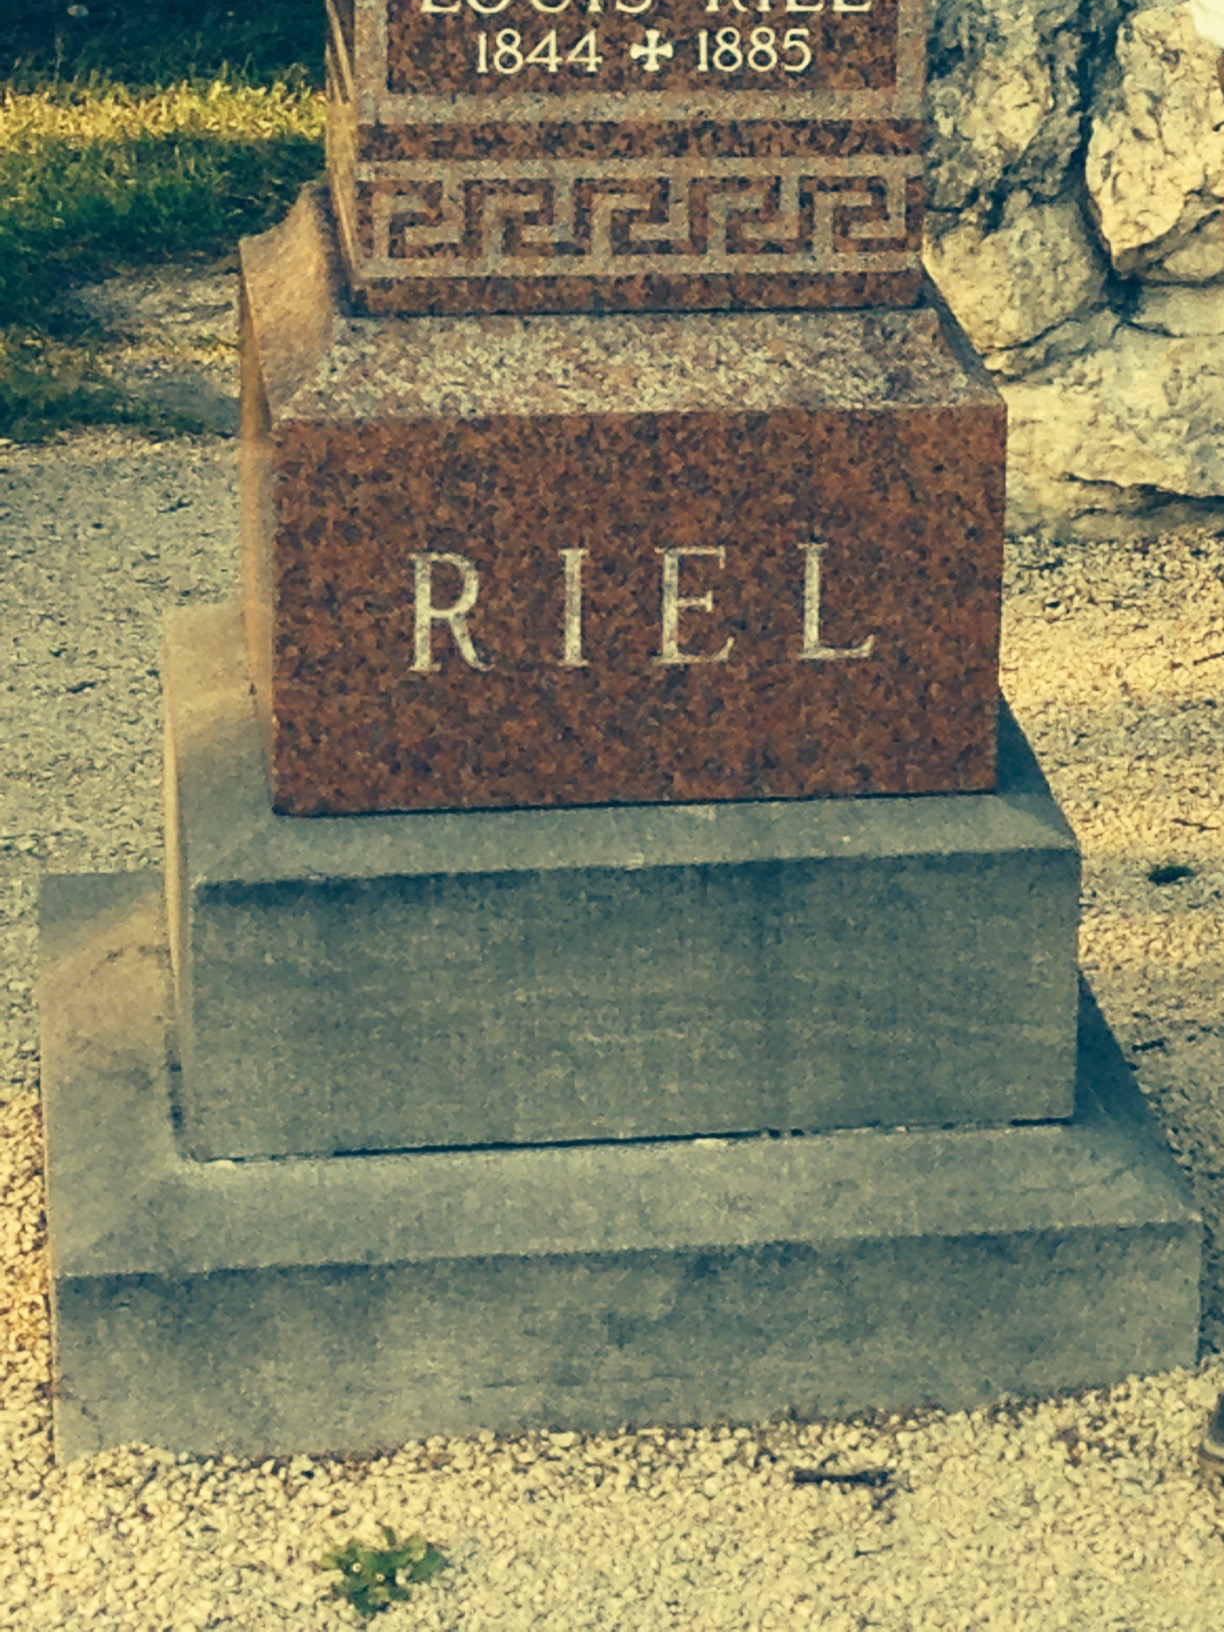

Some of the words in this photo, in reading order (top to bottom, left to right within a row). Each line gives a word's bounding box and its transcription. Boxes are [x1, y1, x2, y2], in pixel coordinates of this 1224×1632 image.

[477, 28, 603, 74] 1844
[697, 26, 811, 72] 1885
[408, 542, 876, 671] RIEL
